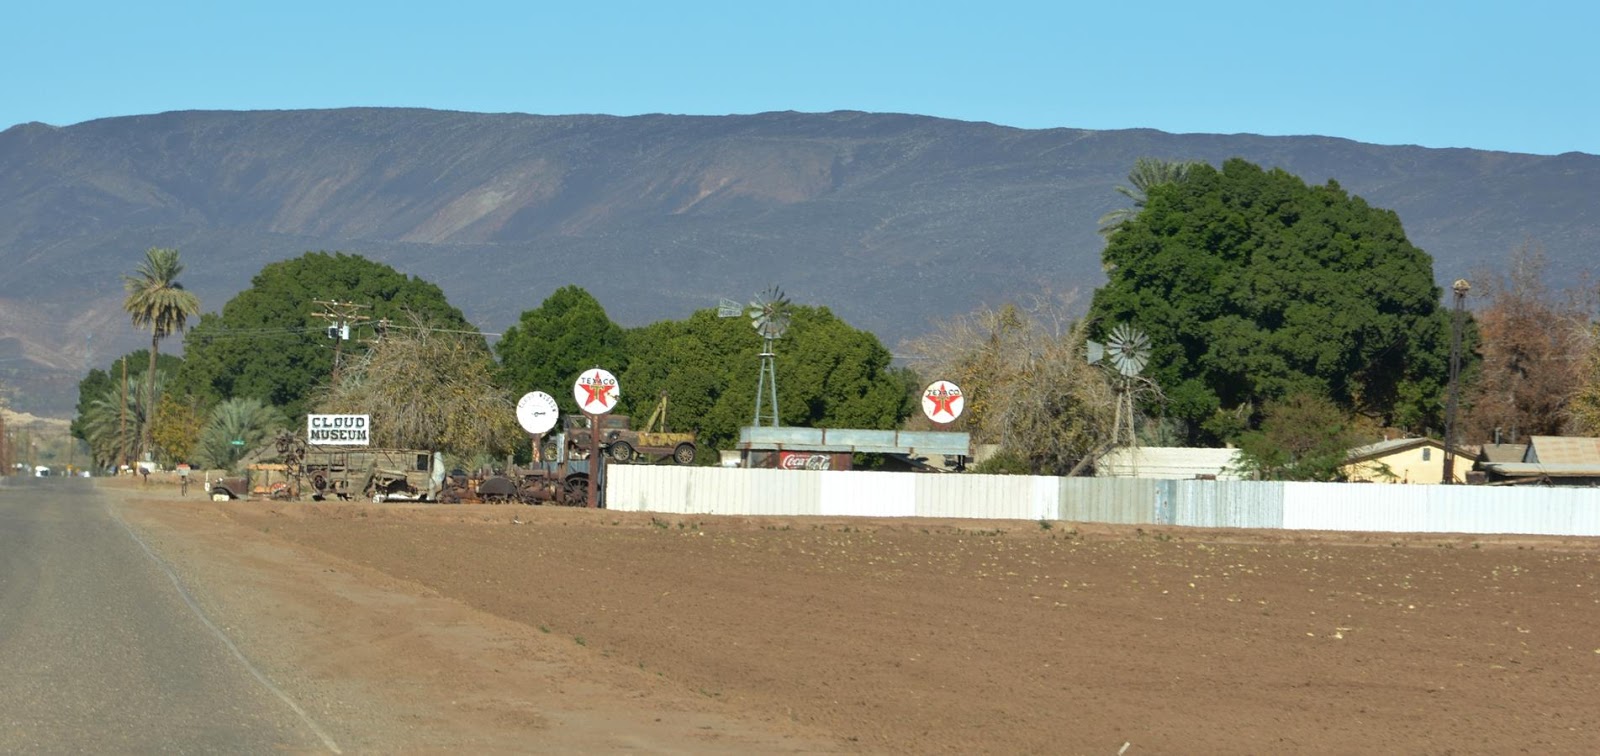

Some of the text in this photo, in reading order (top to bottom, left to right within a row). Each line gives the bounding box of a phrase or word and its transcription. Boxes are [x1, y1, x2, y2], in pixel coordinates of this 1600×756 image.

[581, 377, 615, 385] TEXACO
[312, 417, 365, 428] CLOUD
[310, 429, 367, 440] MUSEUM
